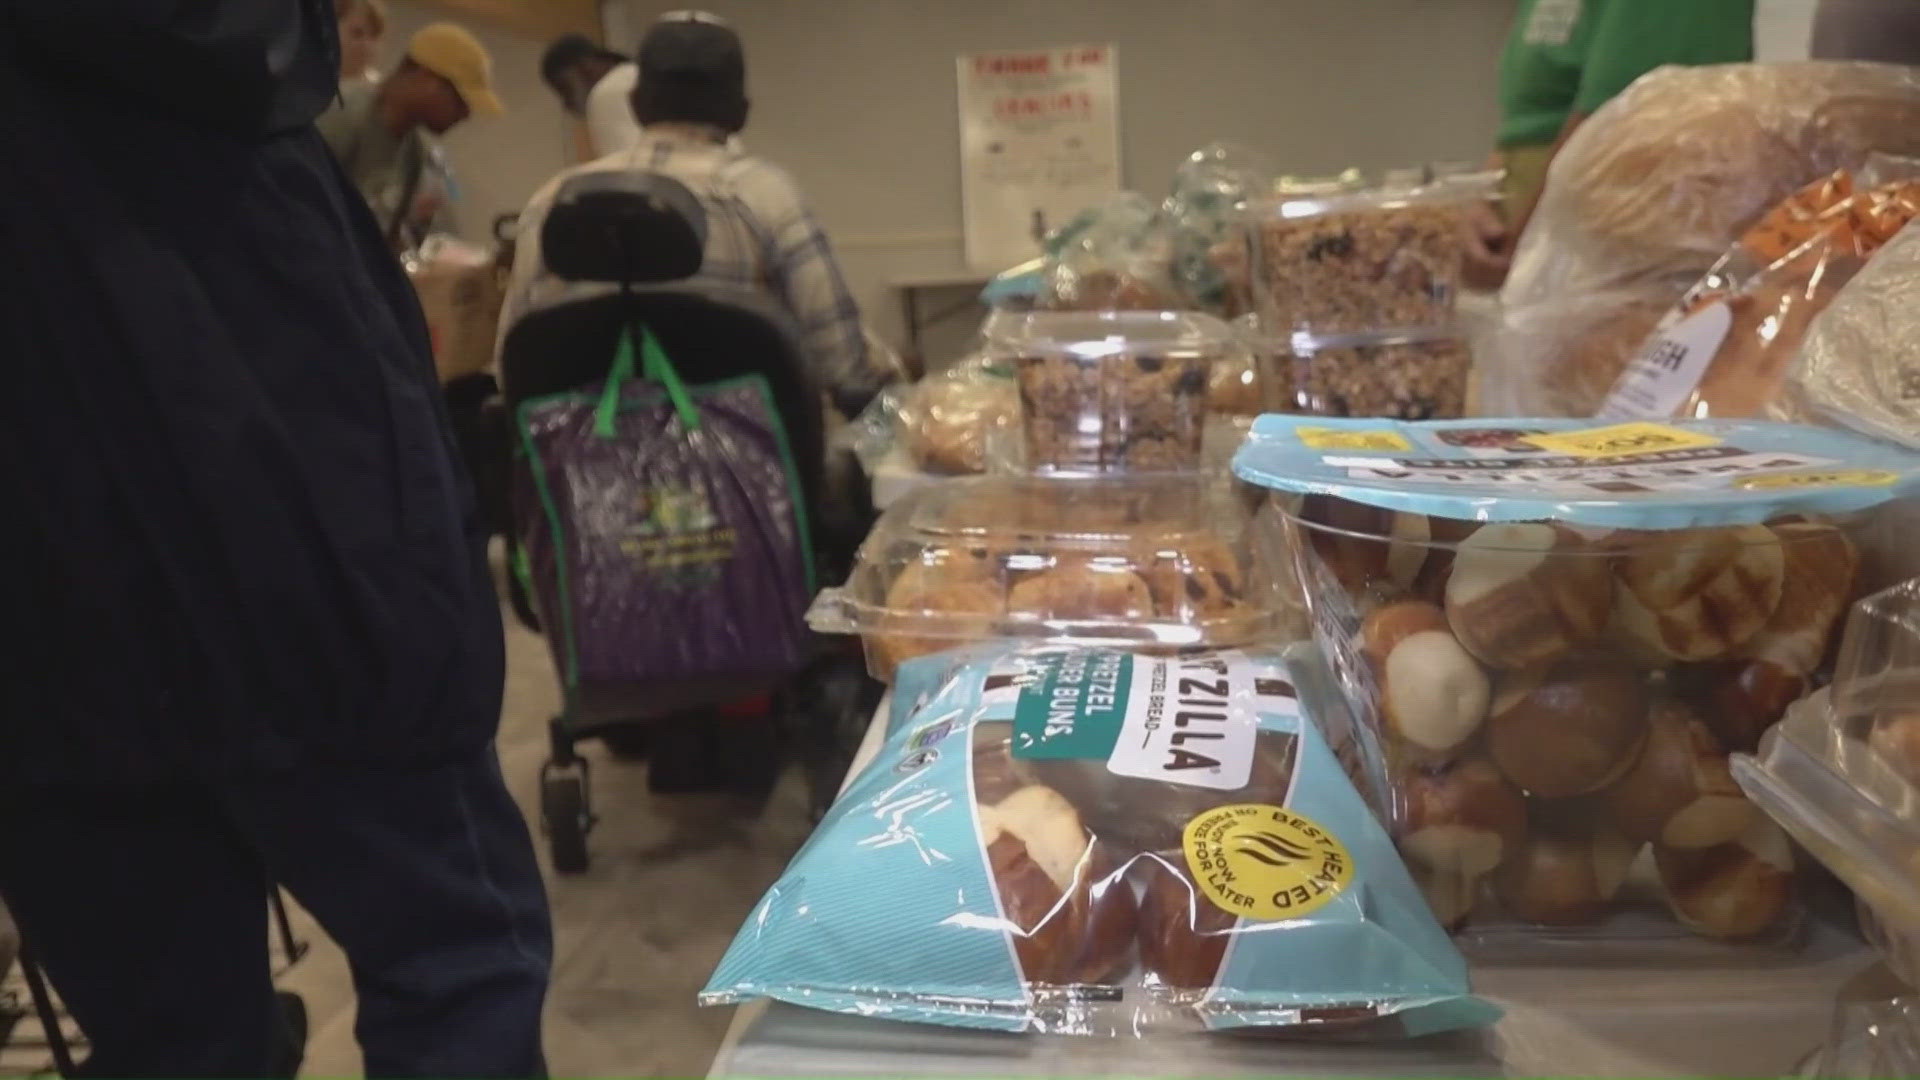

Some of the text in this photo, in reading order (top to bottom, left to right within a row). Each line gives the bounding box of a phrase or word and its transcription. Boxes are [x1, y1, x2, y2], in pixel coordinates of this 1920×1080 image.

[1145, 695, 1165, 731] BREAD
[1194, 841, 1213, 872] FOR
[1208, 873, 1256, 909] LATER
[1212, 847, 1237, 883] NOW
[1272, 811, 1343, 908] BEST HEATED
